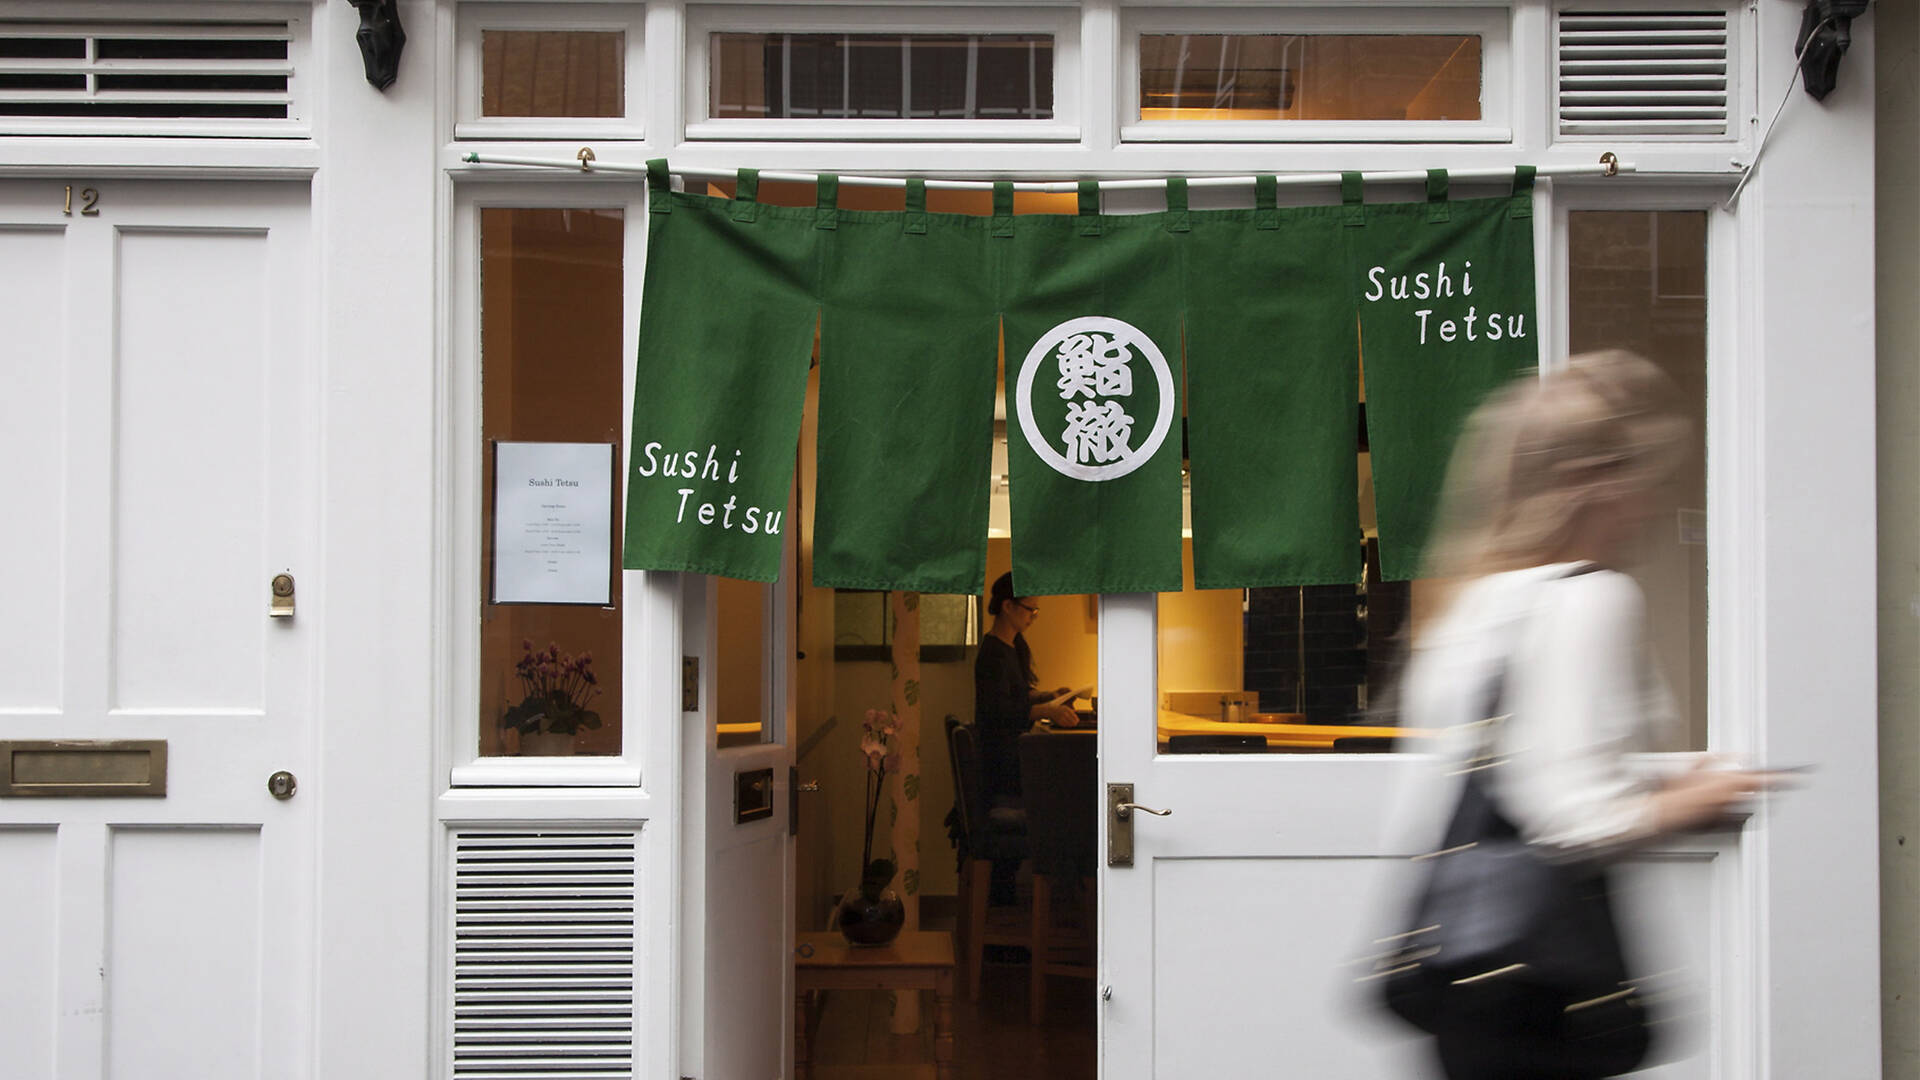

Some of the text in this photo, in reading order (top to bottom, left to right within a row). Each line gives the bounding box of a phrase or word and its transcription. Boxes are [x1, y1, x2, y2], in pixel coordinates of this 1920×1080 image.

[63, 185, 99, 217] 12
[1365, 261, 1473, 302] Sushi
[1414, 307, 1527, 345] Tetsu
[528, 478, 579, 487] Sushi Tetsu
[638, 441, 742, 485] Sushi
[677, 488, 783, 536] Tetsu
